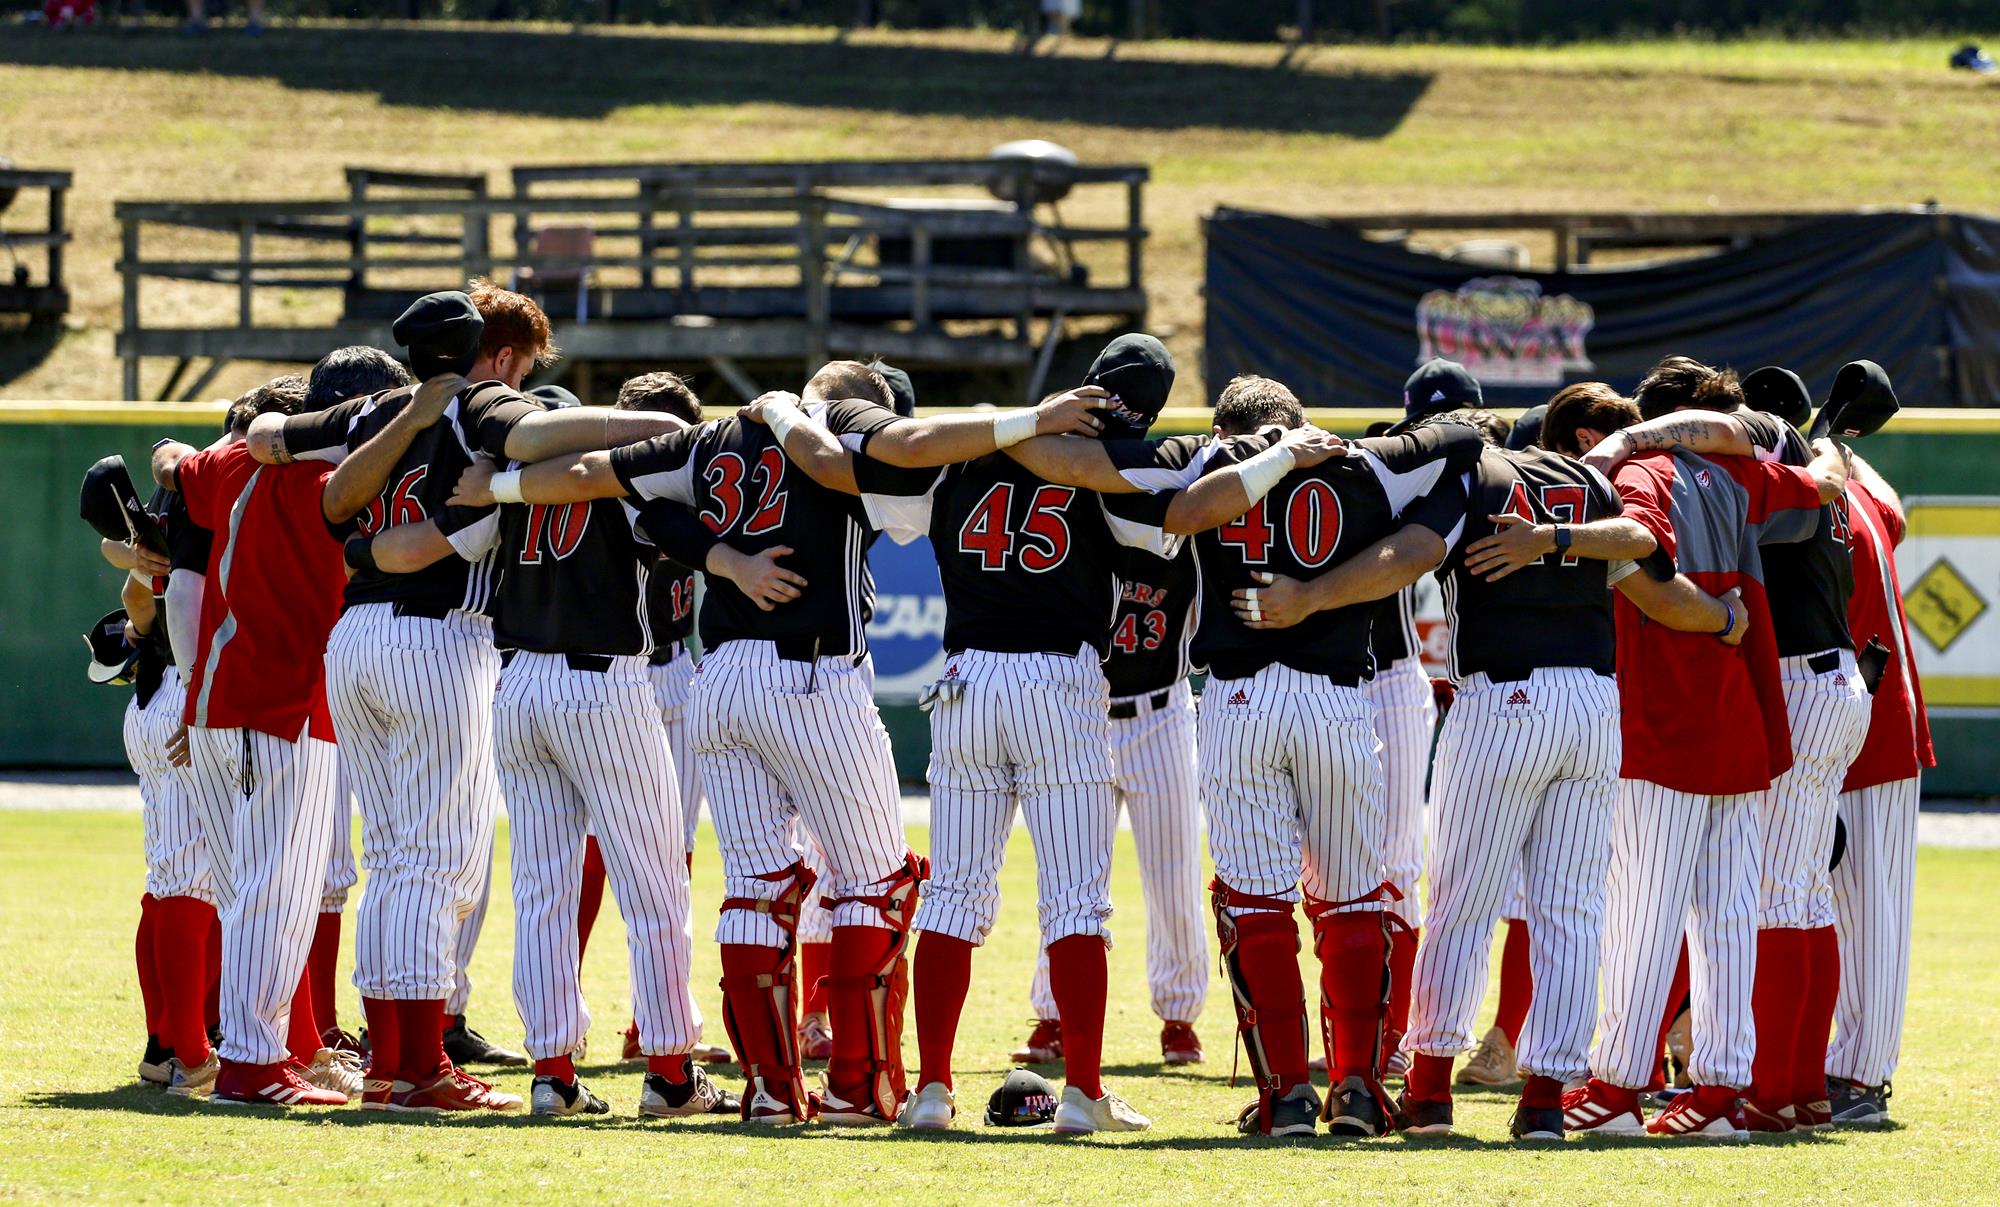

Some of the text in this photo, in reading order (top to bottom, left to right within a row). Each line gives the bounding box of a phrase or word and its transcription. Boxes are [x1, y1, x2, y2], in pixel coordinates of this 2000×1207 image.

[700, 445, 789, 538] 32
[1218, 478, 1343, 568] 40
[519, 502, 592, 565] 10
[959, 481, 1077, 574] 45
[865, 595, 947, 641] CAA
[1122, 580, 1168, 608] ERS
[1113, 610, 1168, 654] 43
